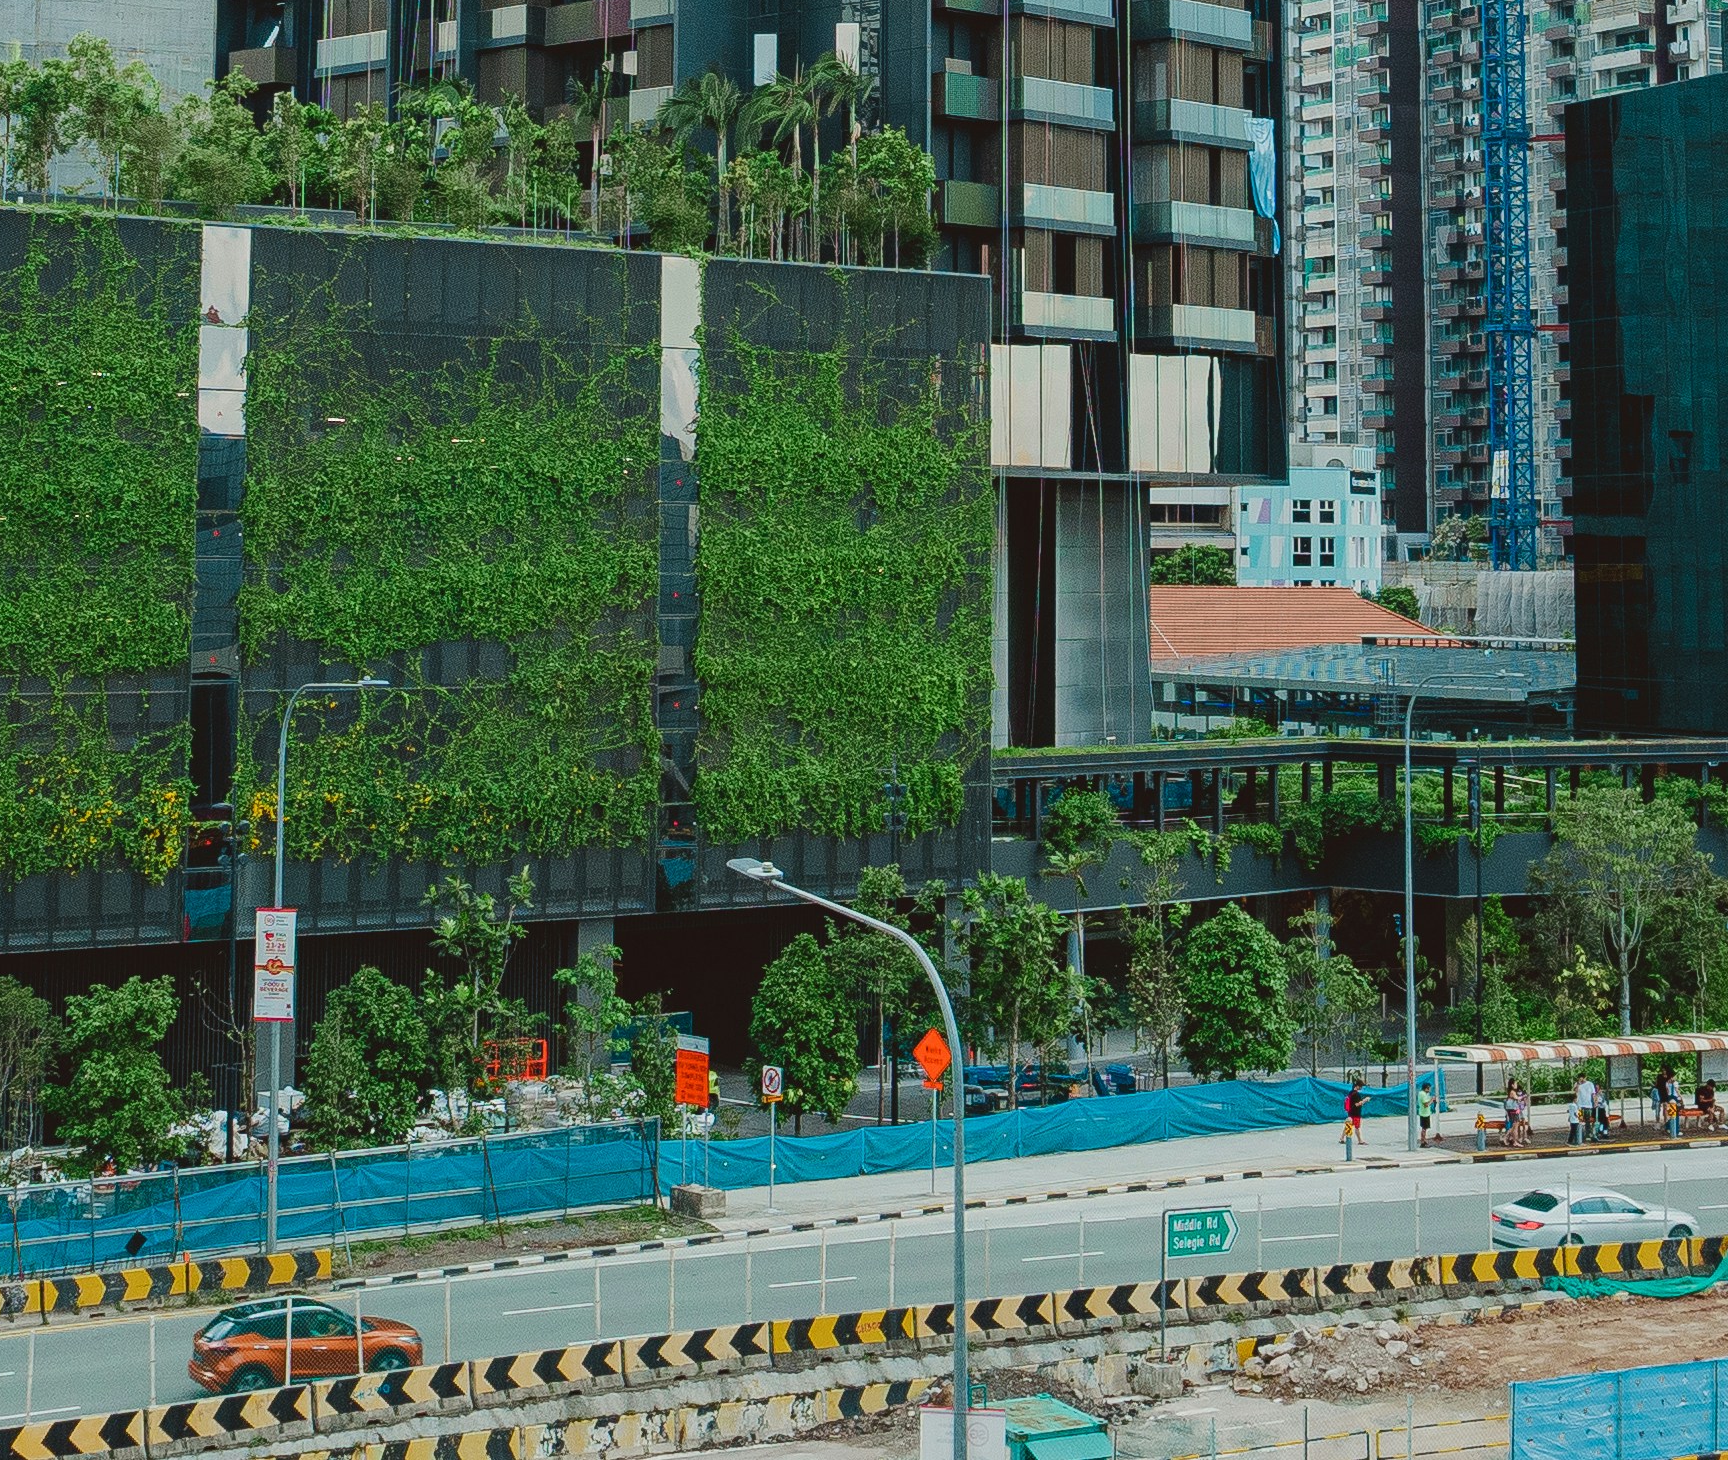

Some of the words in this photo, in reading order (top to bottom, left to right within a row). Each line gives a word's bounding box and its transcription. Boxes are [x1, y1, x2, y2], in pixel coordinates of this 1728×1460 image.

[1173, 1218, 1202, 1232] Middle
[1206, 1216, 1219, 1229] Rd
[1173, 1235, 1205, 1251] Selegie
[1208, 1233, 1221, 1246] Rd
